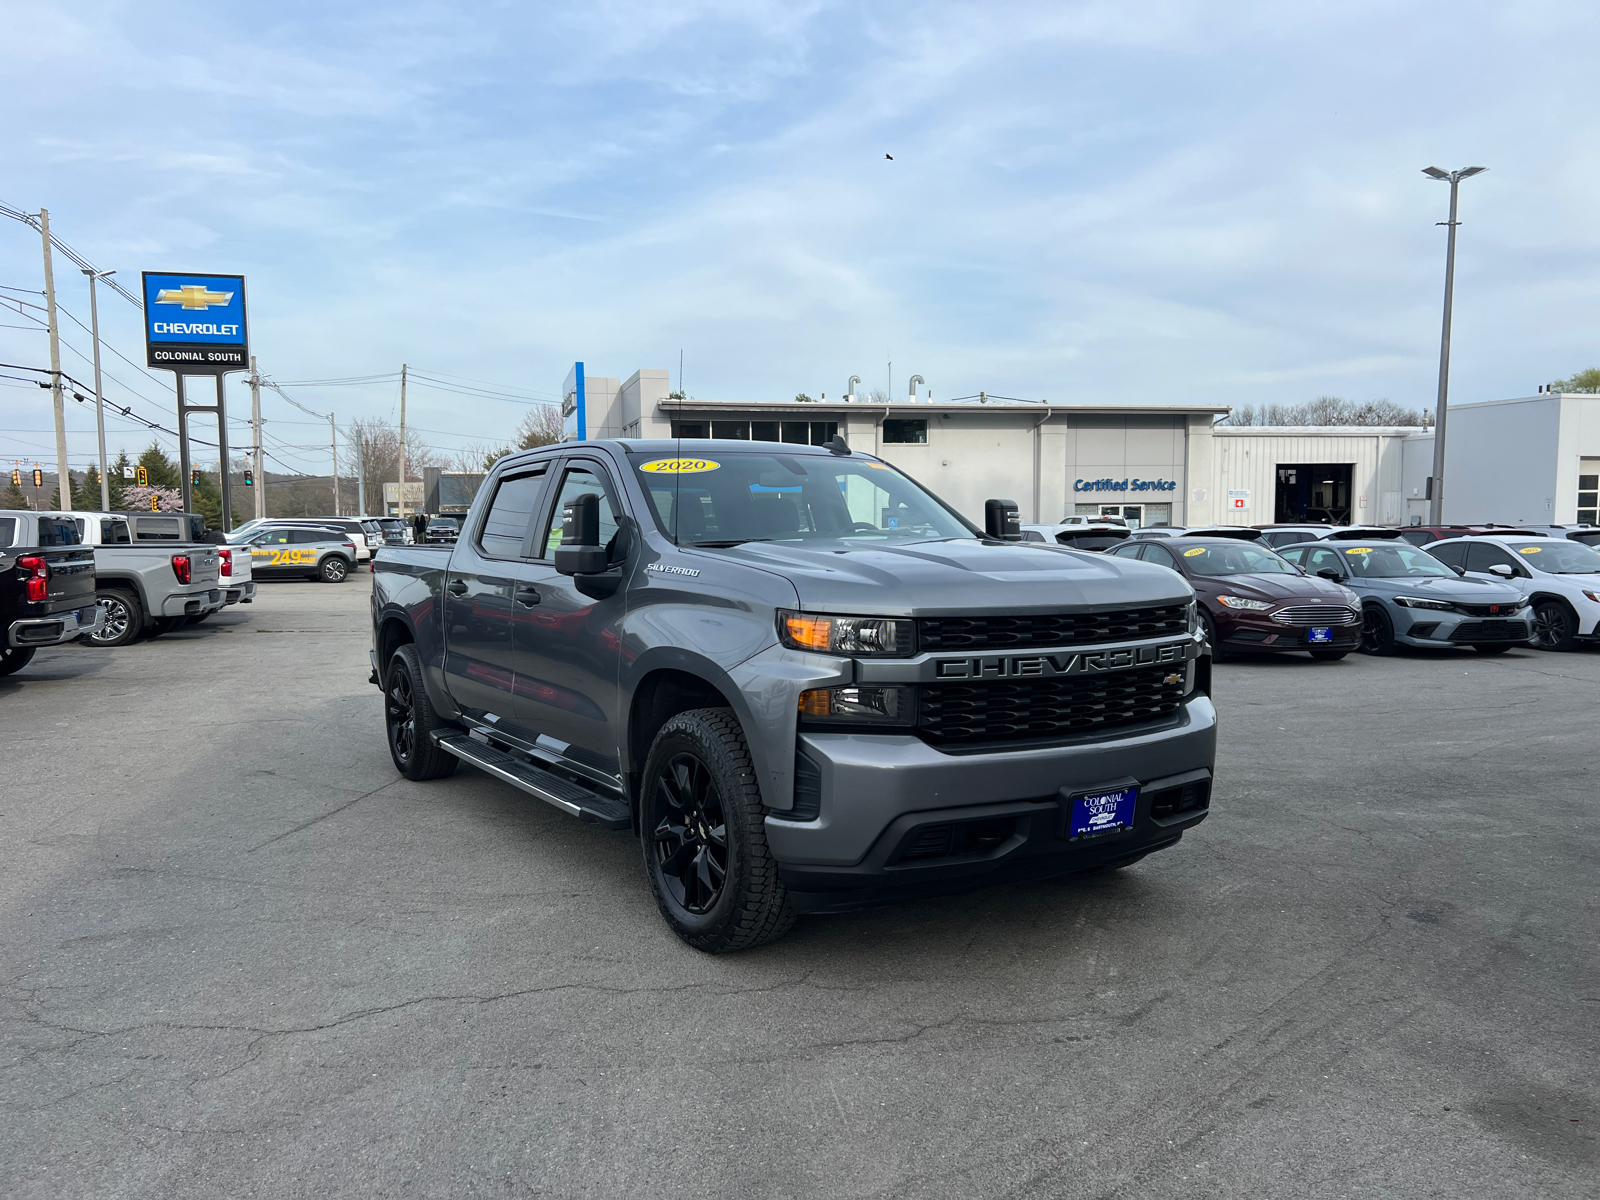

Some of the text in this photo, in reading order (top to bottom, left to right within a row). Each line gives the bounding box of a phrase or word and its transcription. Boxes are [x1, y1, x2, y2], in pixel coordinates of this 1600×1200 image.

[153, 322, 239, 336] CHEVROLET
[154, 351, 241, 362] COLONIAL SOUTH
[655, 460, 707, 472] 2020
[1074, 478, 1177, 492] Certified Service
[647, 563, 701, 578] SILVERADO
[936, 643, 1192, 679] CHEVROLET
[1083, 793, 1124, 807] COLONIAL
[1089, 803, 1117, 815] SOUTH
